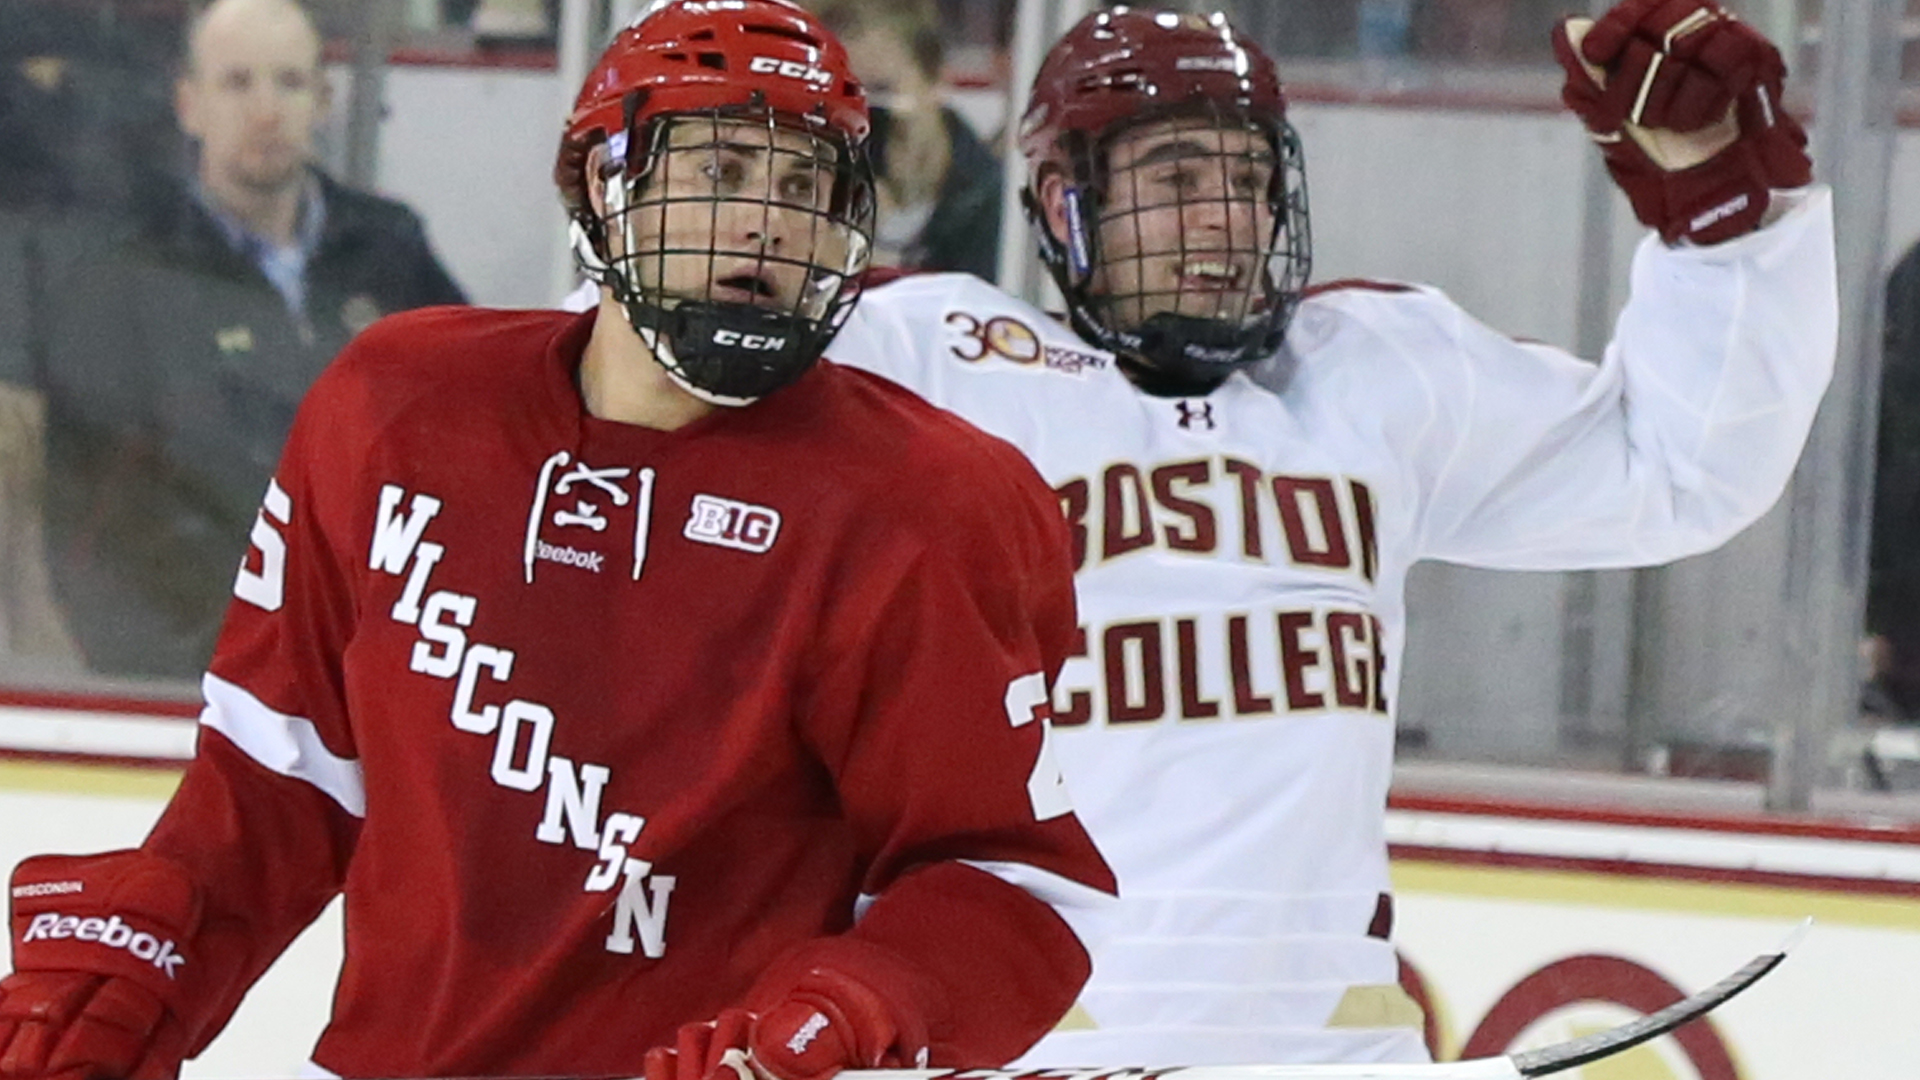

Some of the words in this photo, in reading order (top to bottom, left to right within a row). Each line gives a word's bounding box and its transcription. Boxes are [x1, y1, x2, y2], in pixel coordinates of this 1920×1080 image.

[750, 56, 832, 85] CCM
[713, 328, 785, 351] CCM
[12, 881, 83, 898] WISCONSIN
[22, 912, 186, 980] Reebok
